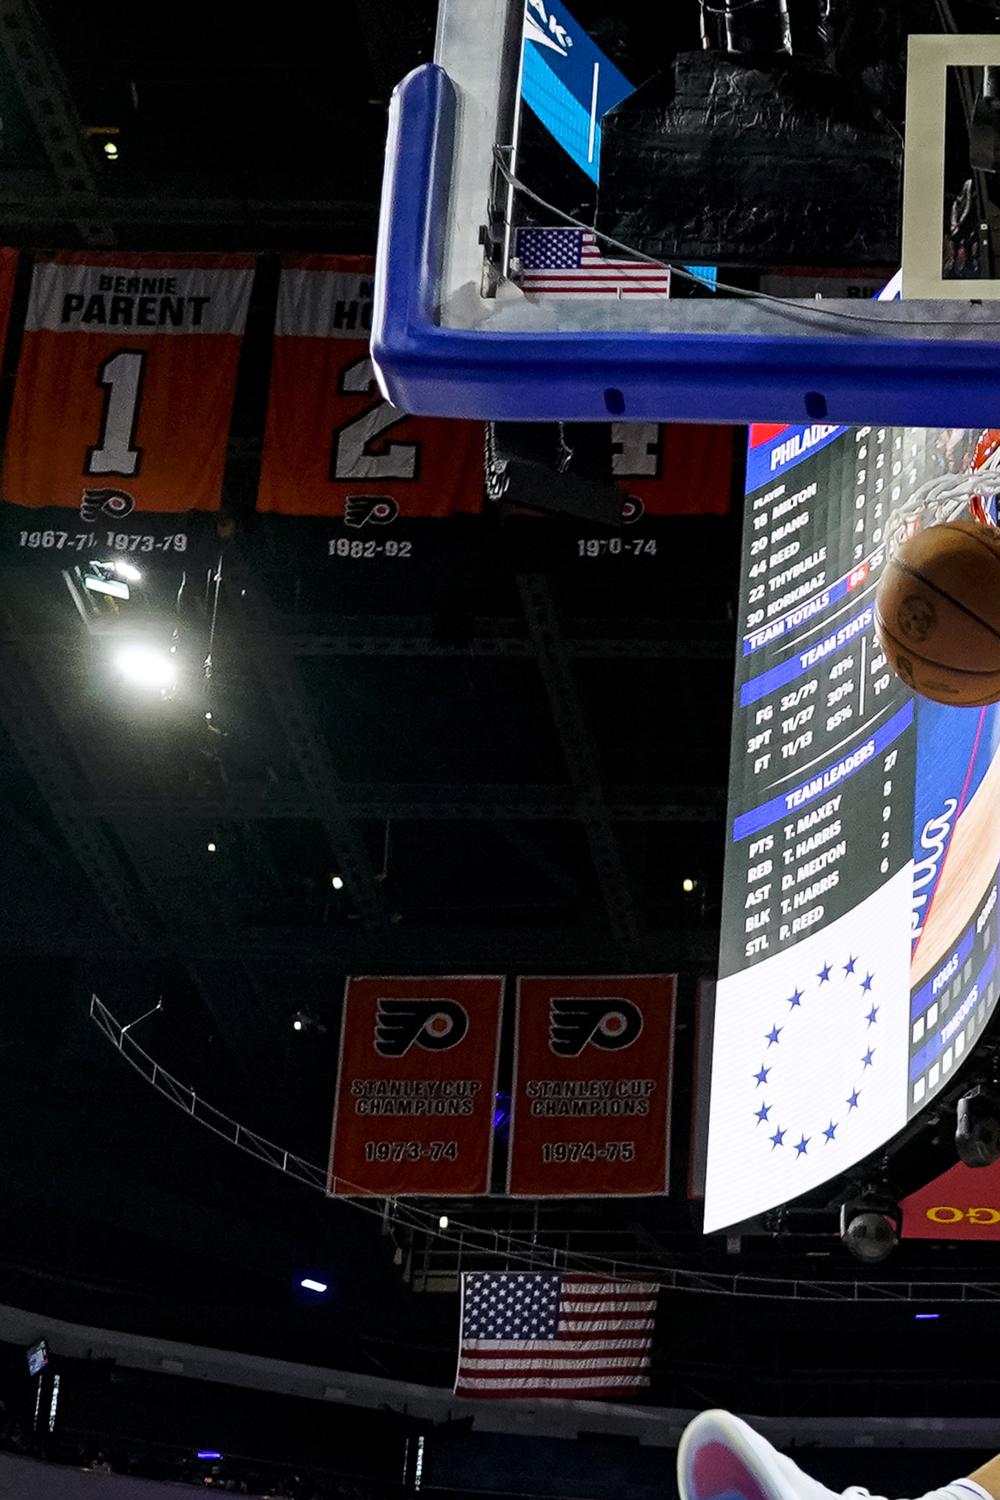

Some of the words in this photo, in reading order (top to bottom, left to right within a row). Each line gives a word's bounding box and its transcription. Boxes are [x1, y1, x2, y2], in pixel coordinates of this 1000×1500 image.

[99, 275, 177, 294] BERNIE
[61, 294, 210, 326] PARENT
[86, 351, 146, 475] 1
[772, 482, 817, 520] MILTON
[106, 531, 188, 551] 1973-79
[327, 538, 413, 557] 1982-92
[750, 537, 768, 555] 20
[771, 511, 809, 544] NIANG
[748, 584, 765, 603] 22
[768, 547, 827, 591] THYBULLE
[749, 560, 767, 577] 44
[769, 542, 800, 568] REED
[747, 609, 764, 628] 30
[767, 571, 826, 617] KORKMAZ
[749, 620, 784, 649] TEAM
[785, 592, 830, 628] TOTALS
[800, 636, 836, 668] TEAM
[837, 608, 872, 644] STATS
[747, 729, 772, 752] 3PT
[782, 704, 814, 734] 11/37
[827, 679, 854, 707] 30%
[754, 754, 771, 774] FT
[781, 731, 813, 758] 11/13
[873, 674, 890, 695] TO
[756, 705, 773, 725] FG
[780, 679, 818, 711] 32/79
[785, 780, 823, 809] TEAM
[823, 740, 876, 788] LEADERS
[749, 835, 774, 858] PTS
[783, 824, 796, 840] T.
[797, 794, 842, 834] MAXEY
[745, 884, 772, 908] AST
[781, 874, 795, 891] D.
[797, 840, 847, 882] MELTON
[747, 860, 773, 883] REB
[782, 849, 795, 865] T.
[796, 820, 842, 859] HARRIS
[745, 908, 770, 932] BLK
[780, 899, 792, 915] T.
[793, 871, 840, 910] HARRIS
[745, 935, 769, 957] STL
[779, 924, 791, 940] P.
[791, 905, 824, 934] REED
[352, 1080, 440, 1097] STANLEY
[442, 1081, 482, 1097] CUP
[356, 1099, 473, 1116] CHAMPIONS
[526, 1080, 614, 1097] STANLEY
[617, 1080, 656, 1096] CUP
[531, 1099, 649, 1117] CHAMPIONS
[365, 1142, 458, 1161] 1973-74
[542, 1142, 634, 1162] 1974-75
